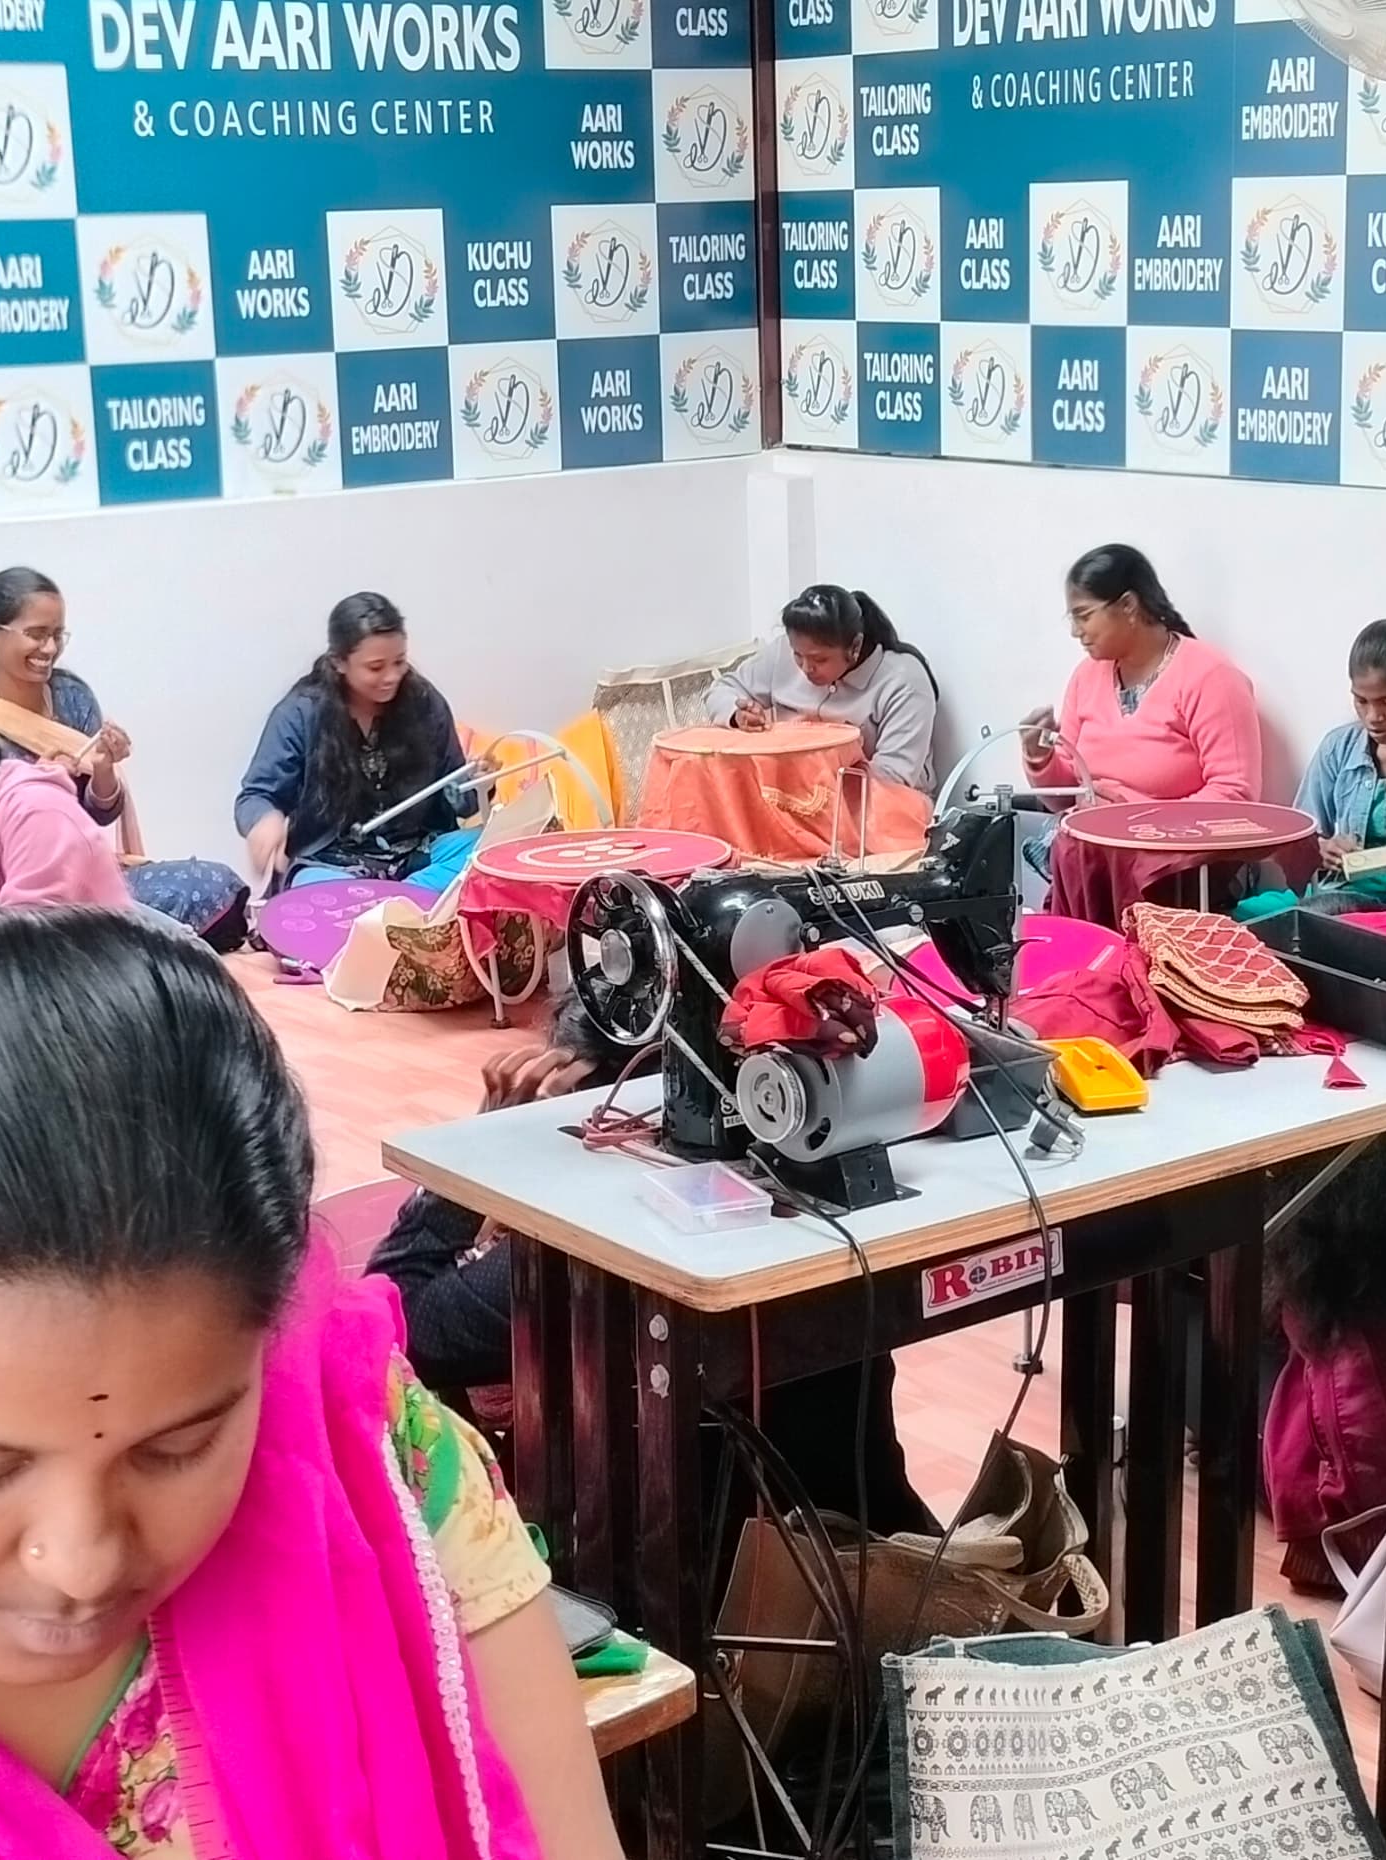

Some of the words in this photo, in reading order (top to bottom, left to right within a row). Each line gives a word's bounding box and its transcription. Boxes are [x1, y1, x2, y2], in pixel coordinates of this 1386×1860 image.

[676, 8, 727, 36] CLASS
[789, 0, 833, 26] CLASS
[954, 0, 1006, 46] DEV
[1017, 0, 1087, 41] AARI
[90, 0, 195, 69] DEV
[212, 1, 331, 71] AARI
[343, 3, 520, 71] WORKS
[972, 75, 983, 109] &
[991, 68, 1100, 107] COACHING
[1110, 60, 1194, 102] CENTER
[1267, 57, 1315, 93] AARI
[860, 83, 931, 117] TAILORING
[134, 101, 154, 136] &
[169, 99, 357, 136] COACHING
[372, 101, 493, 134] CENTER
[581, 104, 622, 132] AARI
[1242, 102, 1338, 139] EMBROIDERY
[571, 141, 634, 169] WORKS
[873, 124, 919, 156] CLASS
[782, 221, 848, 251] TAILORING
[966, 219, 1003, 249] AARI
[1157, 215, 1201, 247] AARI
[468, 242, 531, 271] KUCHU
[669, 234, 745, 263] TAILORING
[248, 250, 294, 280] AARI
[794, 260, 837, 288] CLASS
[961, 259, 1010, 289] CLASS
[1134, 257, 1223, 291] EMBROIDERY
[474, 278, 528, 307] CLASS
[684, 272, 733, 300] CLASS
[237, 287, 309, 318] WORKS
[591, 370, 630, 398] AARI
[864, 353, 933, 384] TAILORING
[1058, 360, 1098, 391] AARI
[1262, 367, 1309, 400] AARI
[107, 396, 205, 430] TAILORING
[374, 383, 417, 413] AARI
[876, 391, 921, 421] CLASS
[581, 404, 642, 433] WORKS
[1053, 400, 1105, 432] CLASS
[1238, 408, 1332, 445] EMBROIDERY
[352, 420, 439, 454] EMBROIDERY
[127, 438, 191, 471] CLASS
[931, 1240, 1055, 1305] ROBIN
